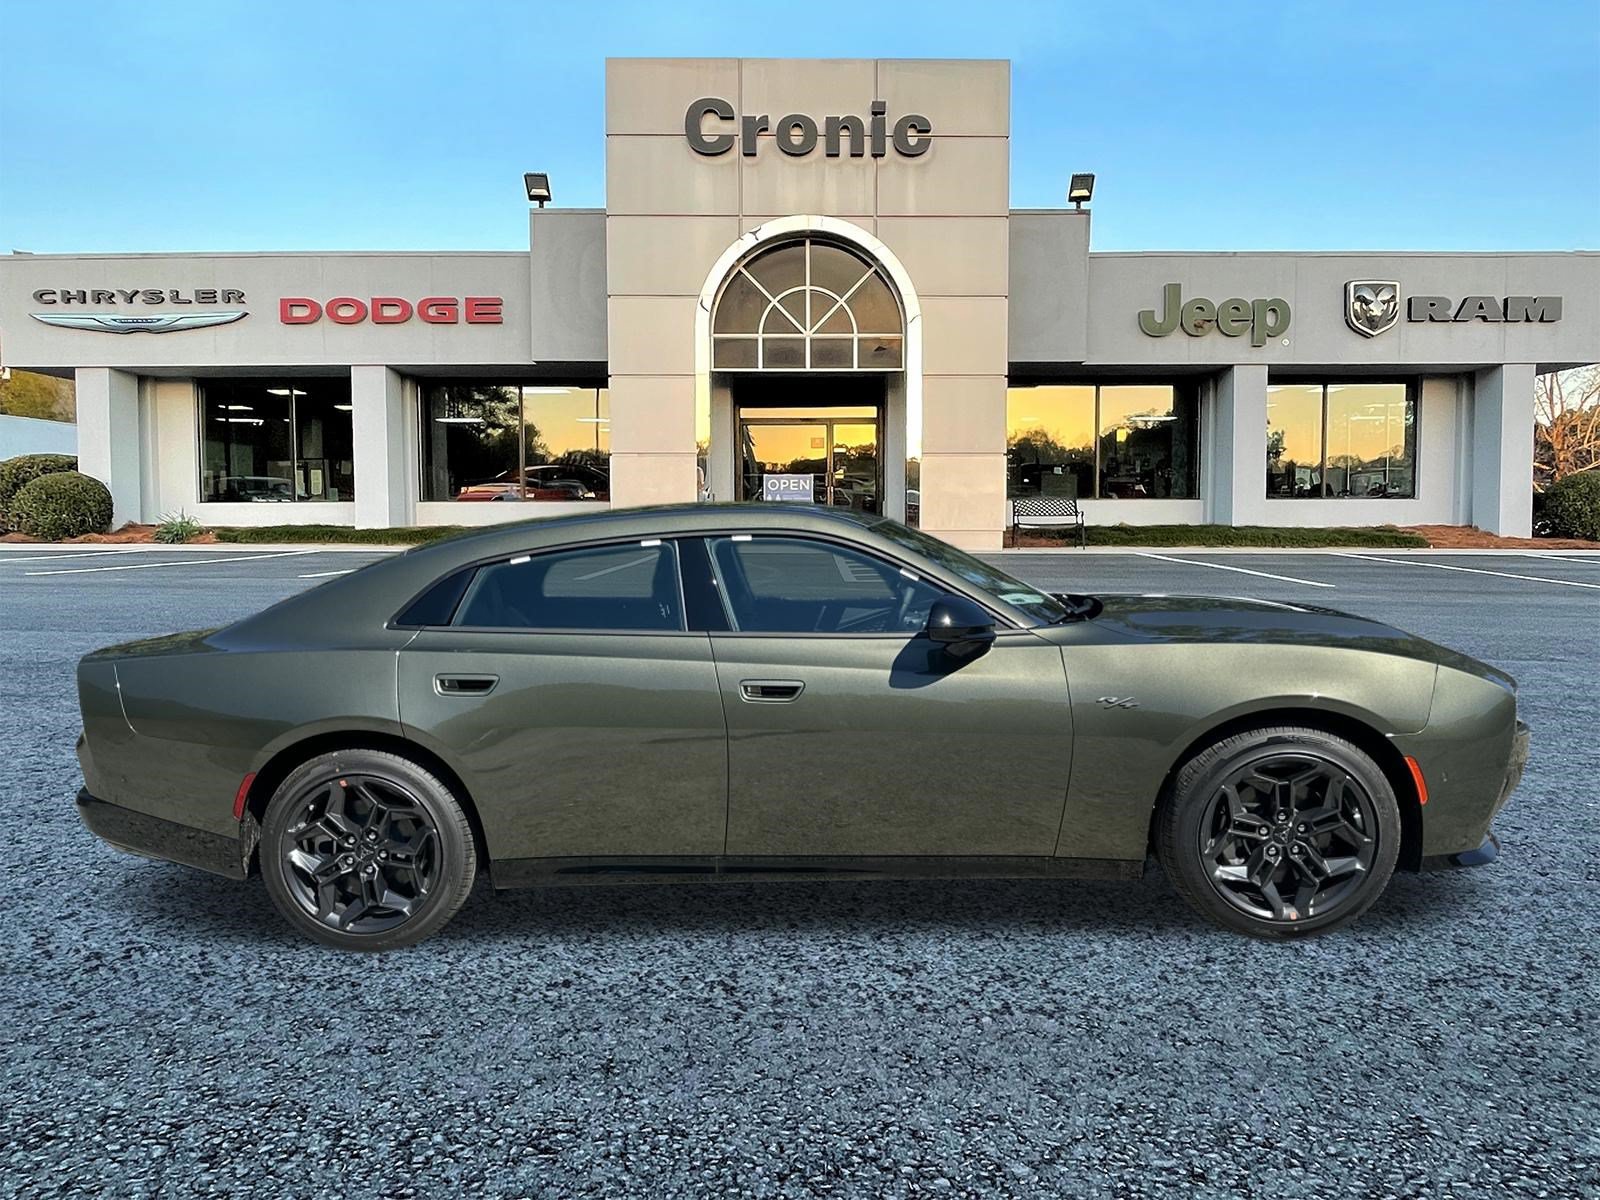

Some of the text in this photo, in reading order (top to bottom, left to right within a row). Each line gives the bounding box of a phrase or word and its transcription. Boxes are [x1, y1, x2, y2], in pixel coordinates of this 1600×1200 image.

[685, 97, 932, 157] Cronic
[32, 288, 246, 304] CHRYSLER
[1407, 296, 1562, 322] RAM
[279, 297, 503, 324] DODGE
[1138, 283, 1291, 347] Jeep
[767, 479, 810, 491] OPEN
